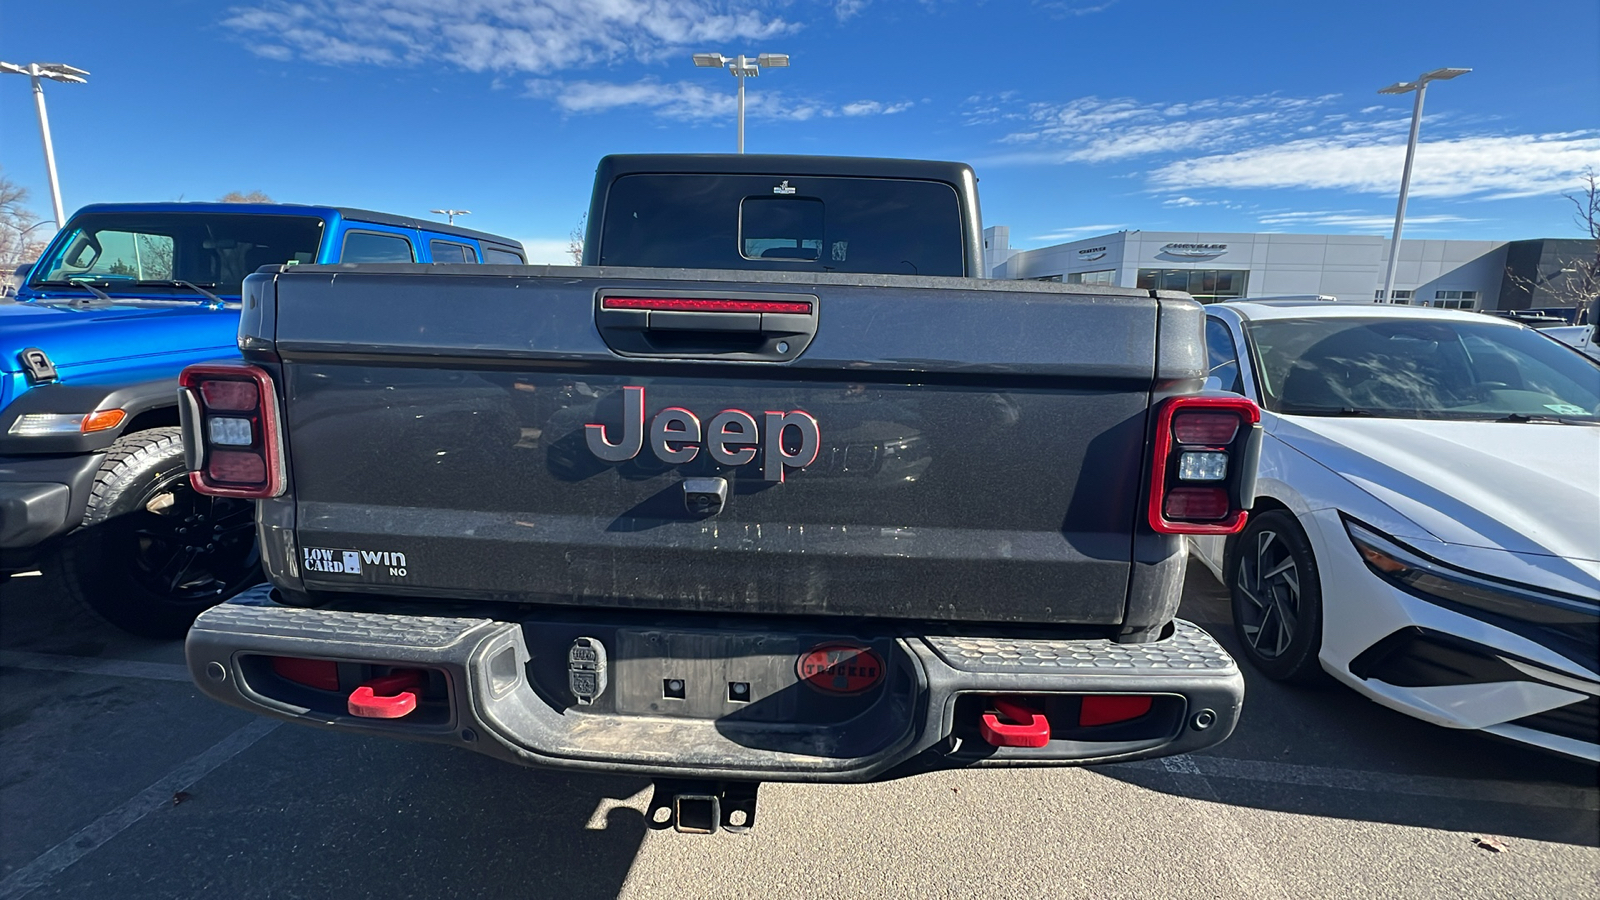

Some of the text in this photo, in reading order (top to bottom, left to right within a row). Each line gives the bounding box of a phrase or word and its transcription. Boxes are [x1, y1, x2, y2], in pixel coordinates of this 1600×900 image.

[585, 385, 821, 483] Jeep
[303, 547, 334, 561] LOW
[304, 559, 344, 573] CARD
[389, 567, 407, 577] NO
